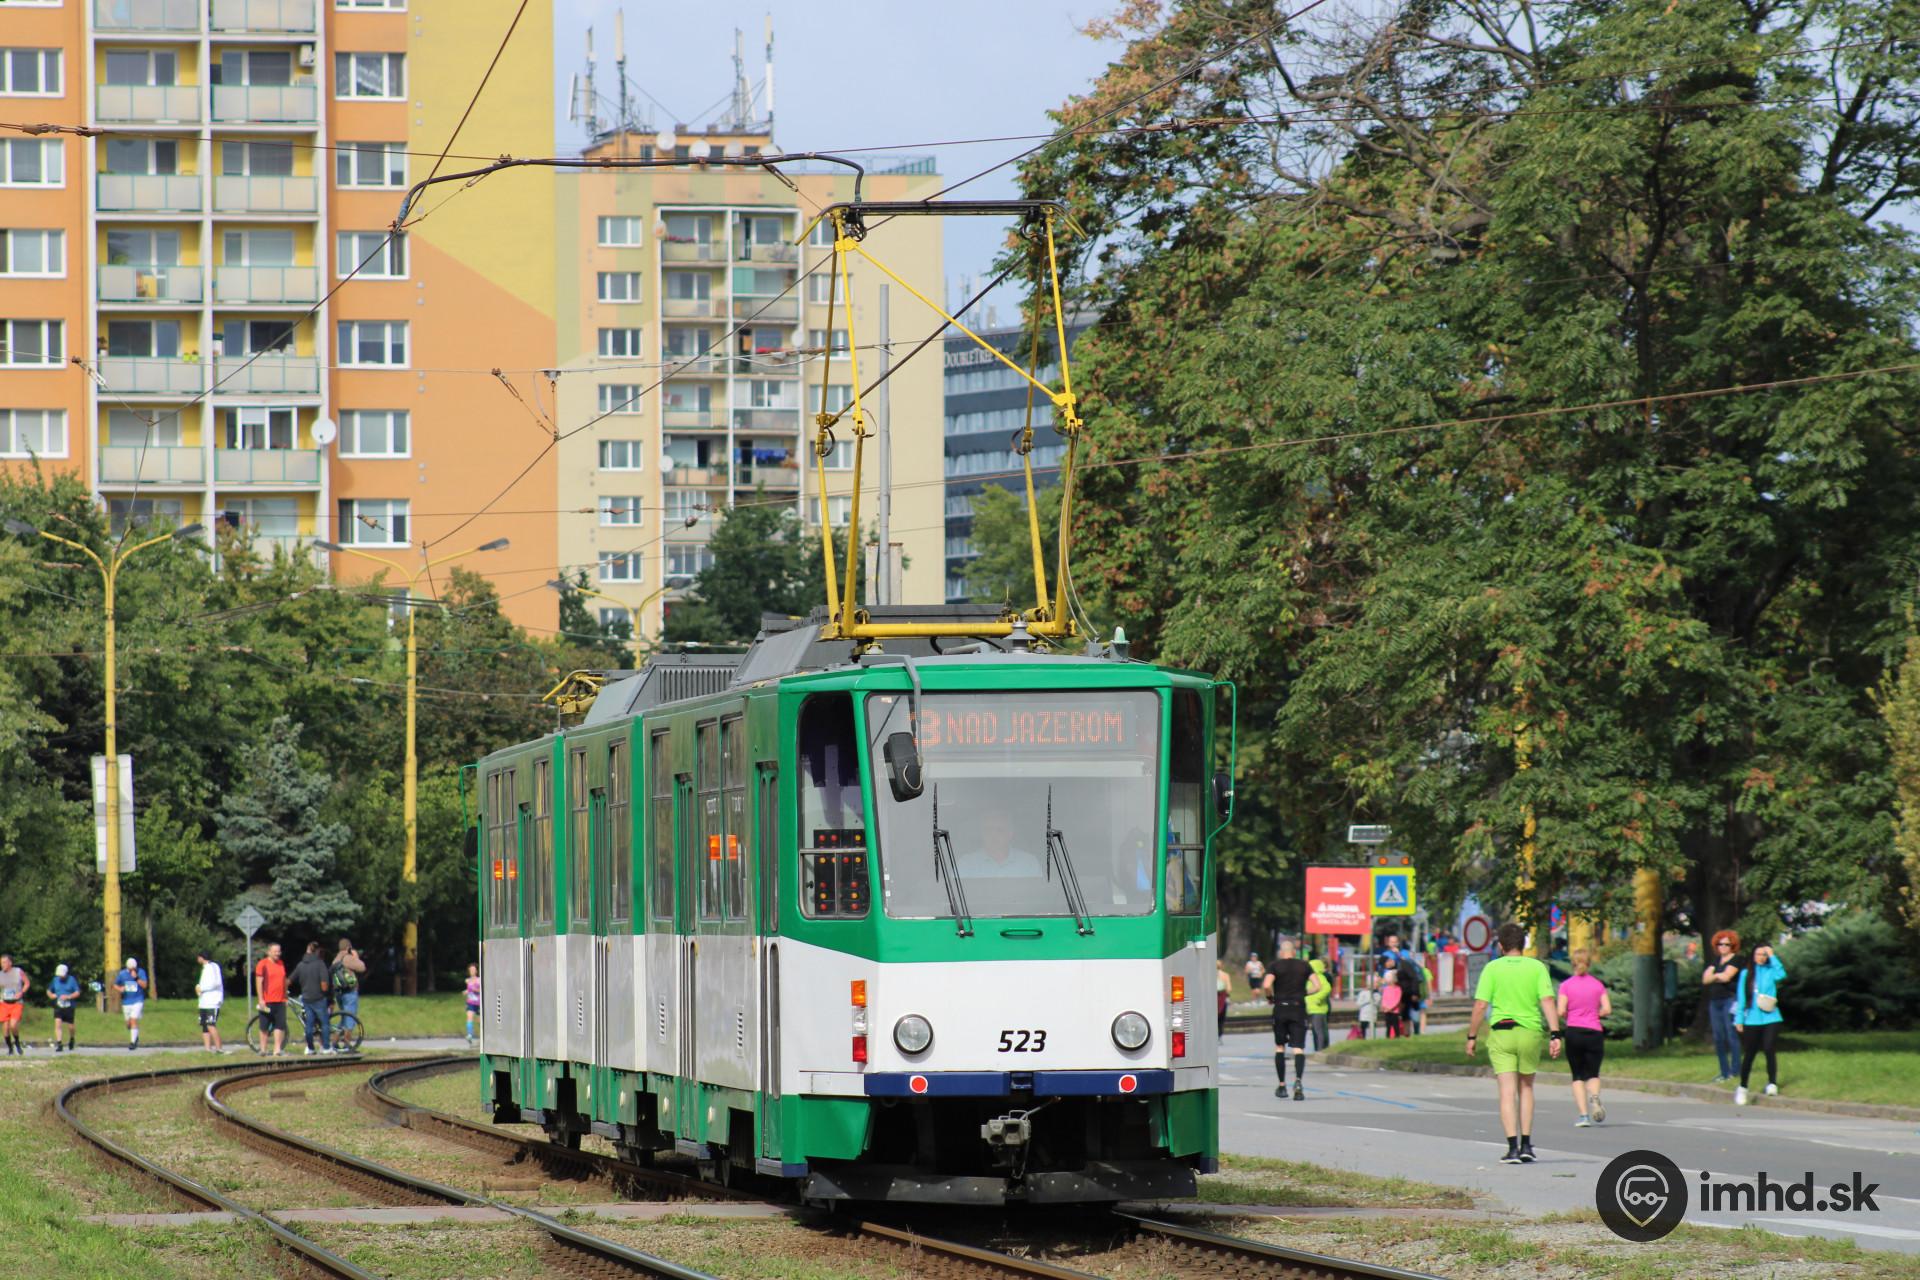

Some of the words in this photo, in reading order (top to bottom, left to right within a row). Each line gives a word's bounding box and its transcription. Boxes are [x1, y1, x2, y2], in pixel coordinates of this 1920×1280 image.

[947, 711, 997, 744] NAD
[1003, 711, 1123, 744] JAZEROM
[997, 1030, 1047, 1052] 523
